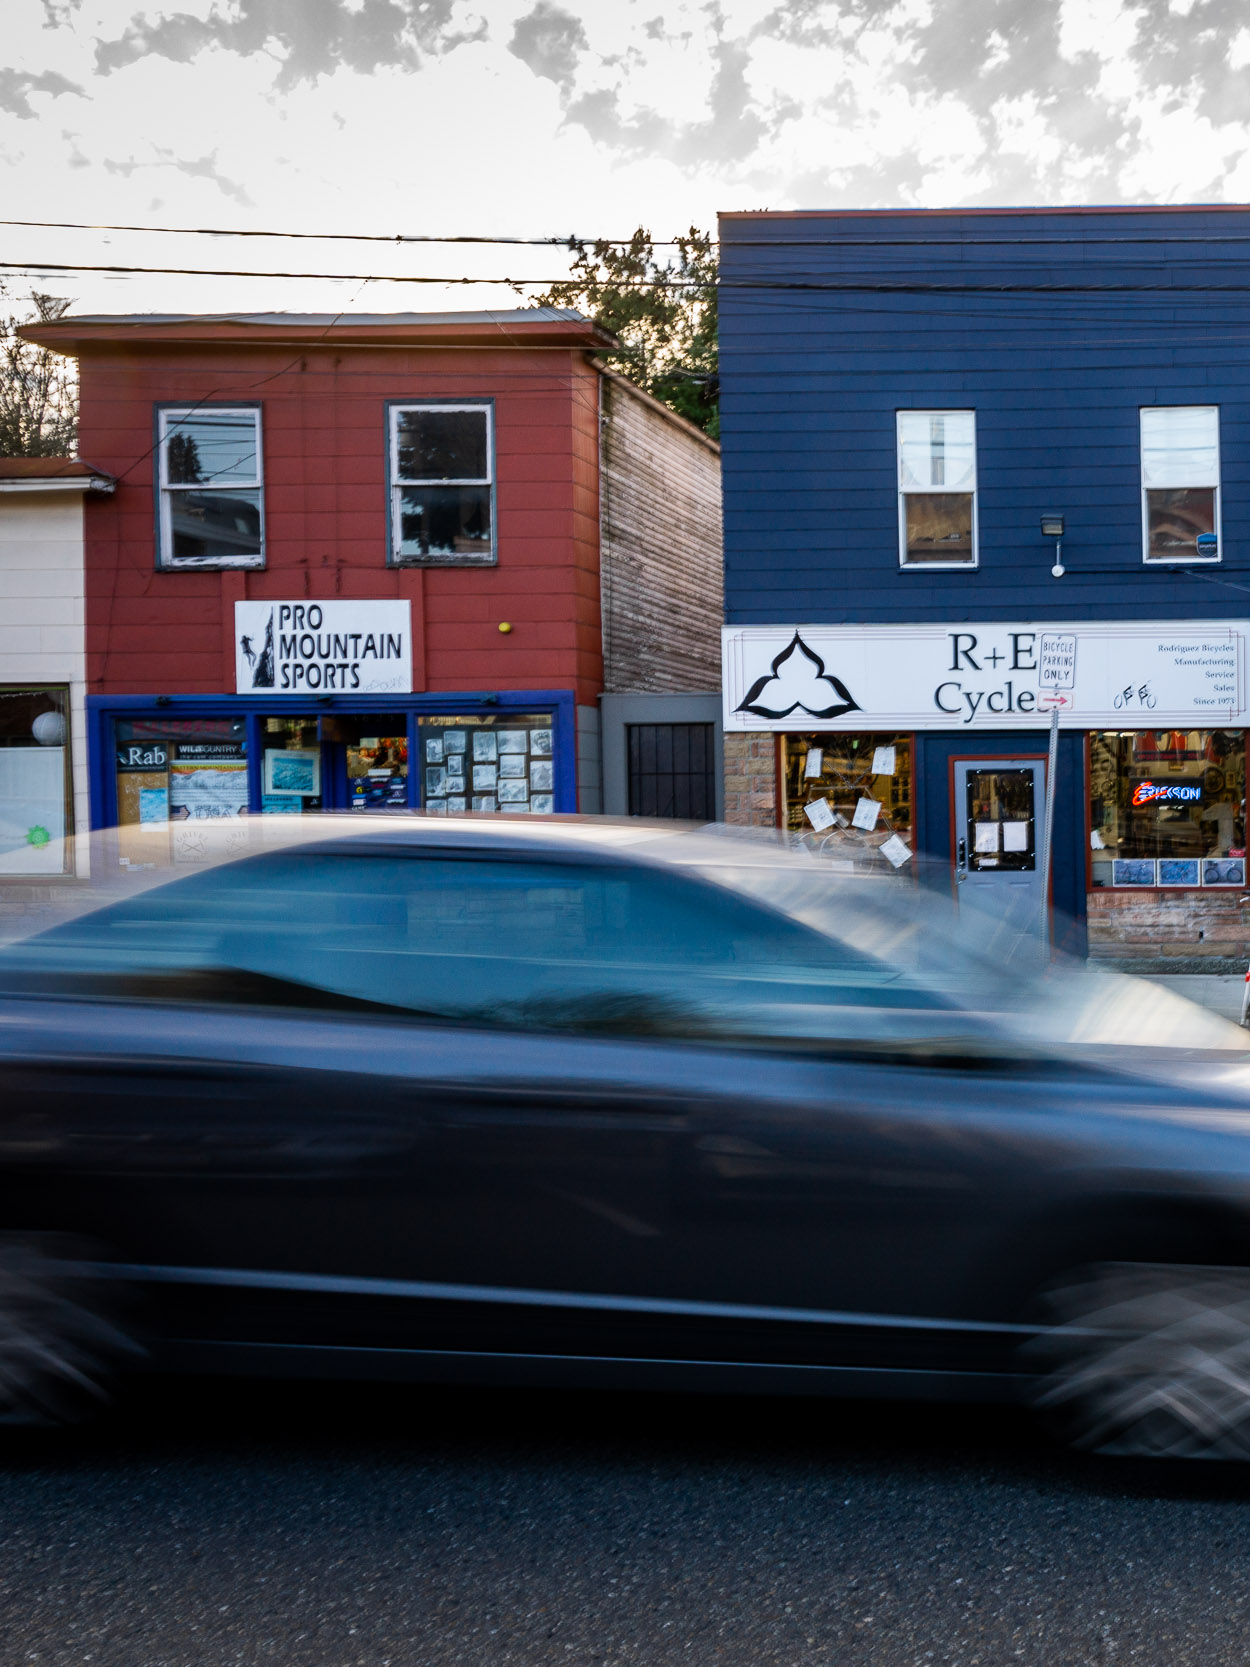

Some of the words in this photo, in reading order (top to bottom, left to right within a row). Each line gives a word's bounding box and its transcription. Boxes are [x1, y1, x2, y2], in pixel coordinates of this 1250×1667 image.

[279, 604, 323, 631] PRO
[279, 633, 402, 660] MOUNTAIN
[948, 633, 1037, 671] R+E
[1044, 642, 1073, 653] BICYCLE
[1158, 644, 1200, 653] Rodriguez
[1201, 644, 1235, 653] Bicycles
[1043, 655, 1073, 667] PARKING
[1174, 658, 1235, 667] Manufacturing
[280, 662, 360, 689] SPORTS
[1044, 669, 1070, 680] ONLY
[1205, 671, 1235, 679] Service
[1213, 684, 1235, 692] Sales
[934, 681, 1050, 724] Cycle
[1193, 698, 1216, 706] Since
[128, 746, 168, 765] Rab
